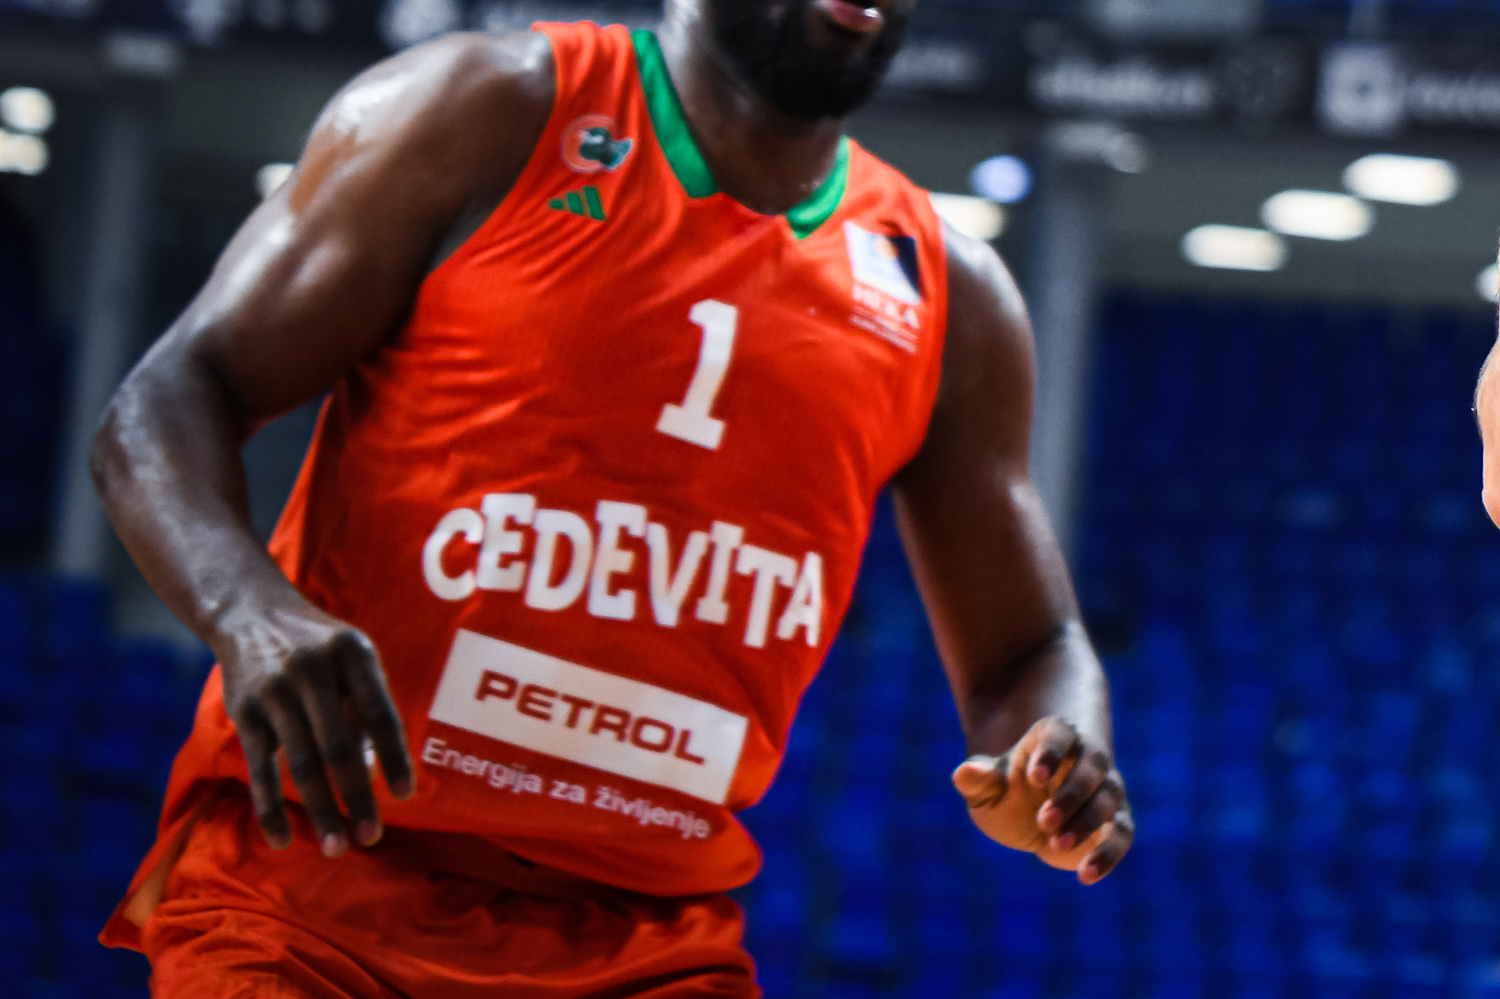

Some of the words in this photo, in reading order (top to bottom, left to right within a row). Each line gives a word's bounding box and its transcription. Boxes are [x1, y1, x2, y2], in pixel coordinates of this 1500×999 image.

[655, 298, 738, 451] 1
[421, 491, 824, 650] CEDEVITA
[474, 668, 707, 766] PETROL
[420, 736, 543, 795] Energija
[548, 779, 588, 804] za
[592, 785, 712, 840] življenje
